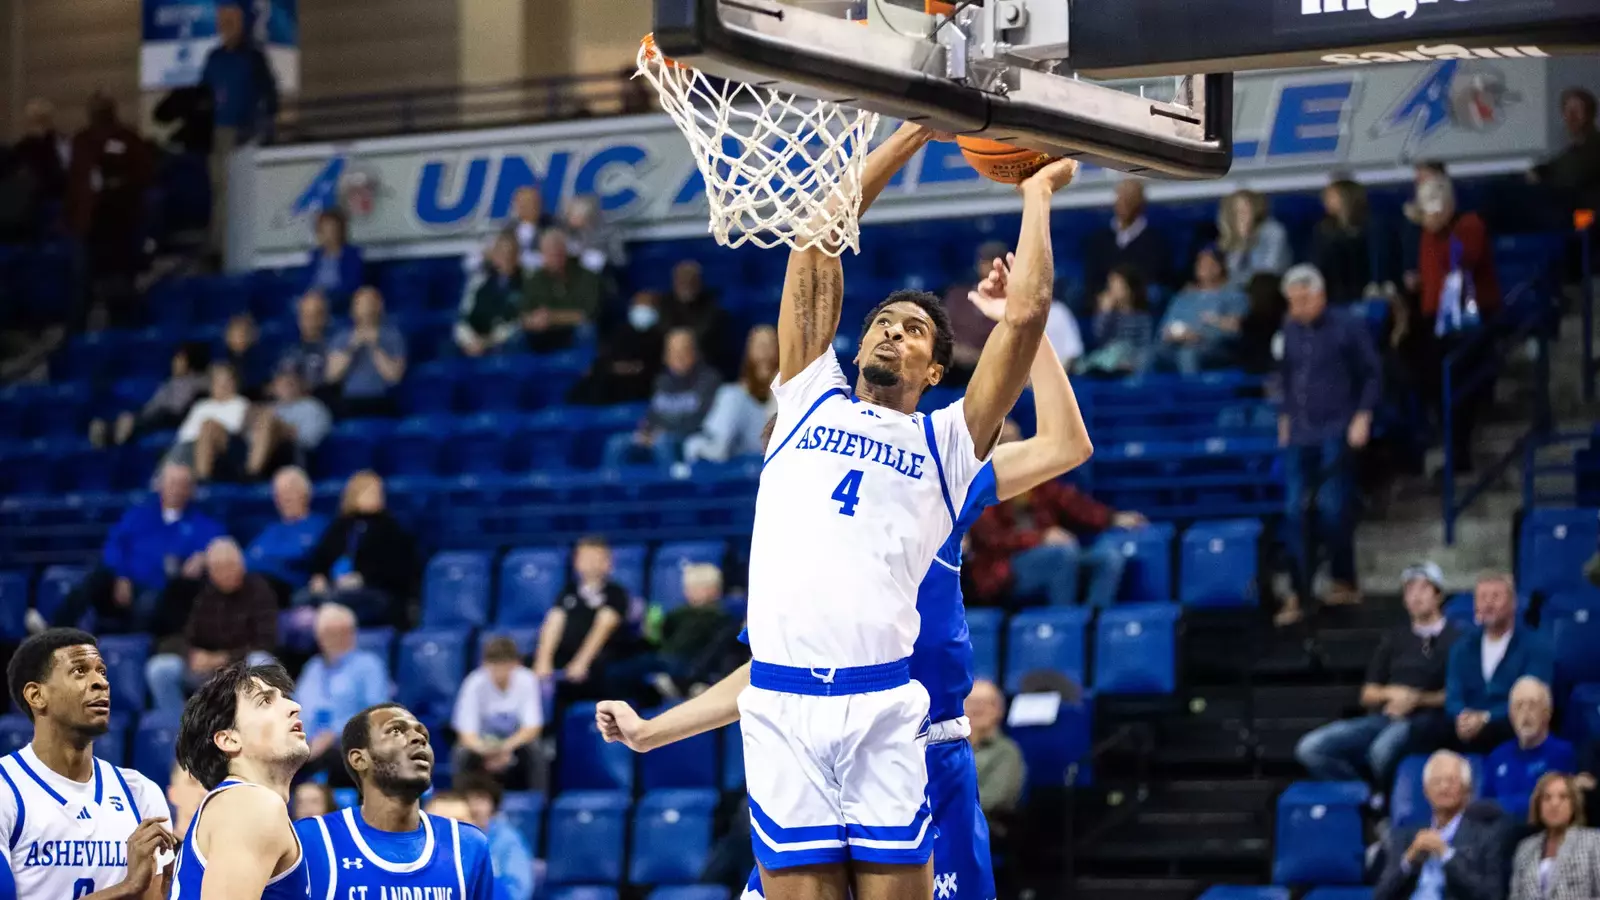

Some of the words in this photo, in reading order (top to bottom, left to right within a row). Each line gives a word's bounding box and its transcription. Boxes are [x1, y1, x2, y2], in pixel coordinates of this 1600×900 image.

[416, 144, 648, 224] UNC
[796, 425, 926, 480] ASHEVILLE
[831, 469, 865, 517] 4
[24, 840, 129, 867] ASHEVILL
